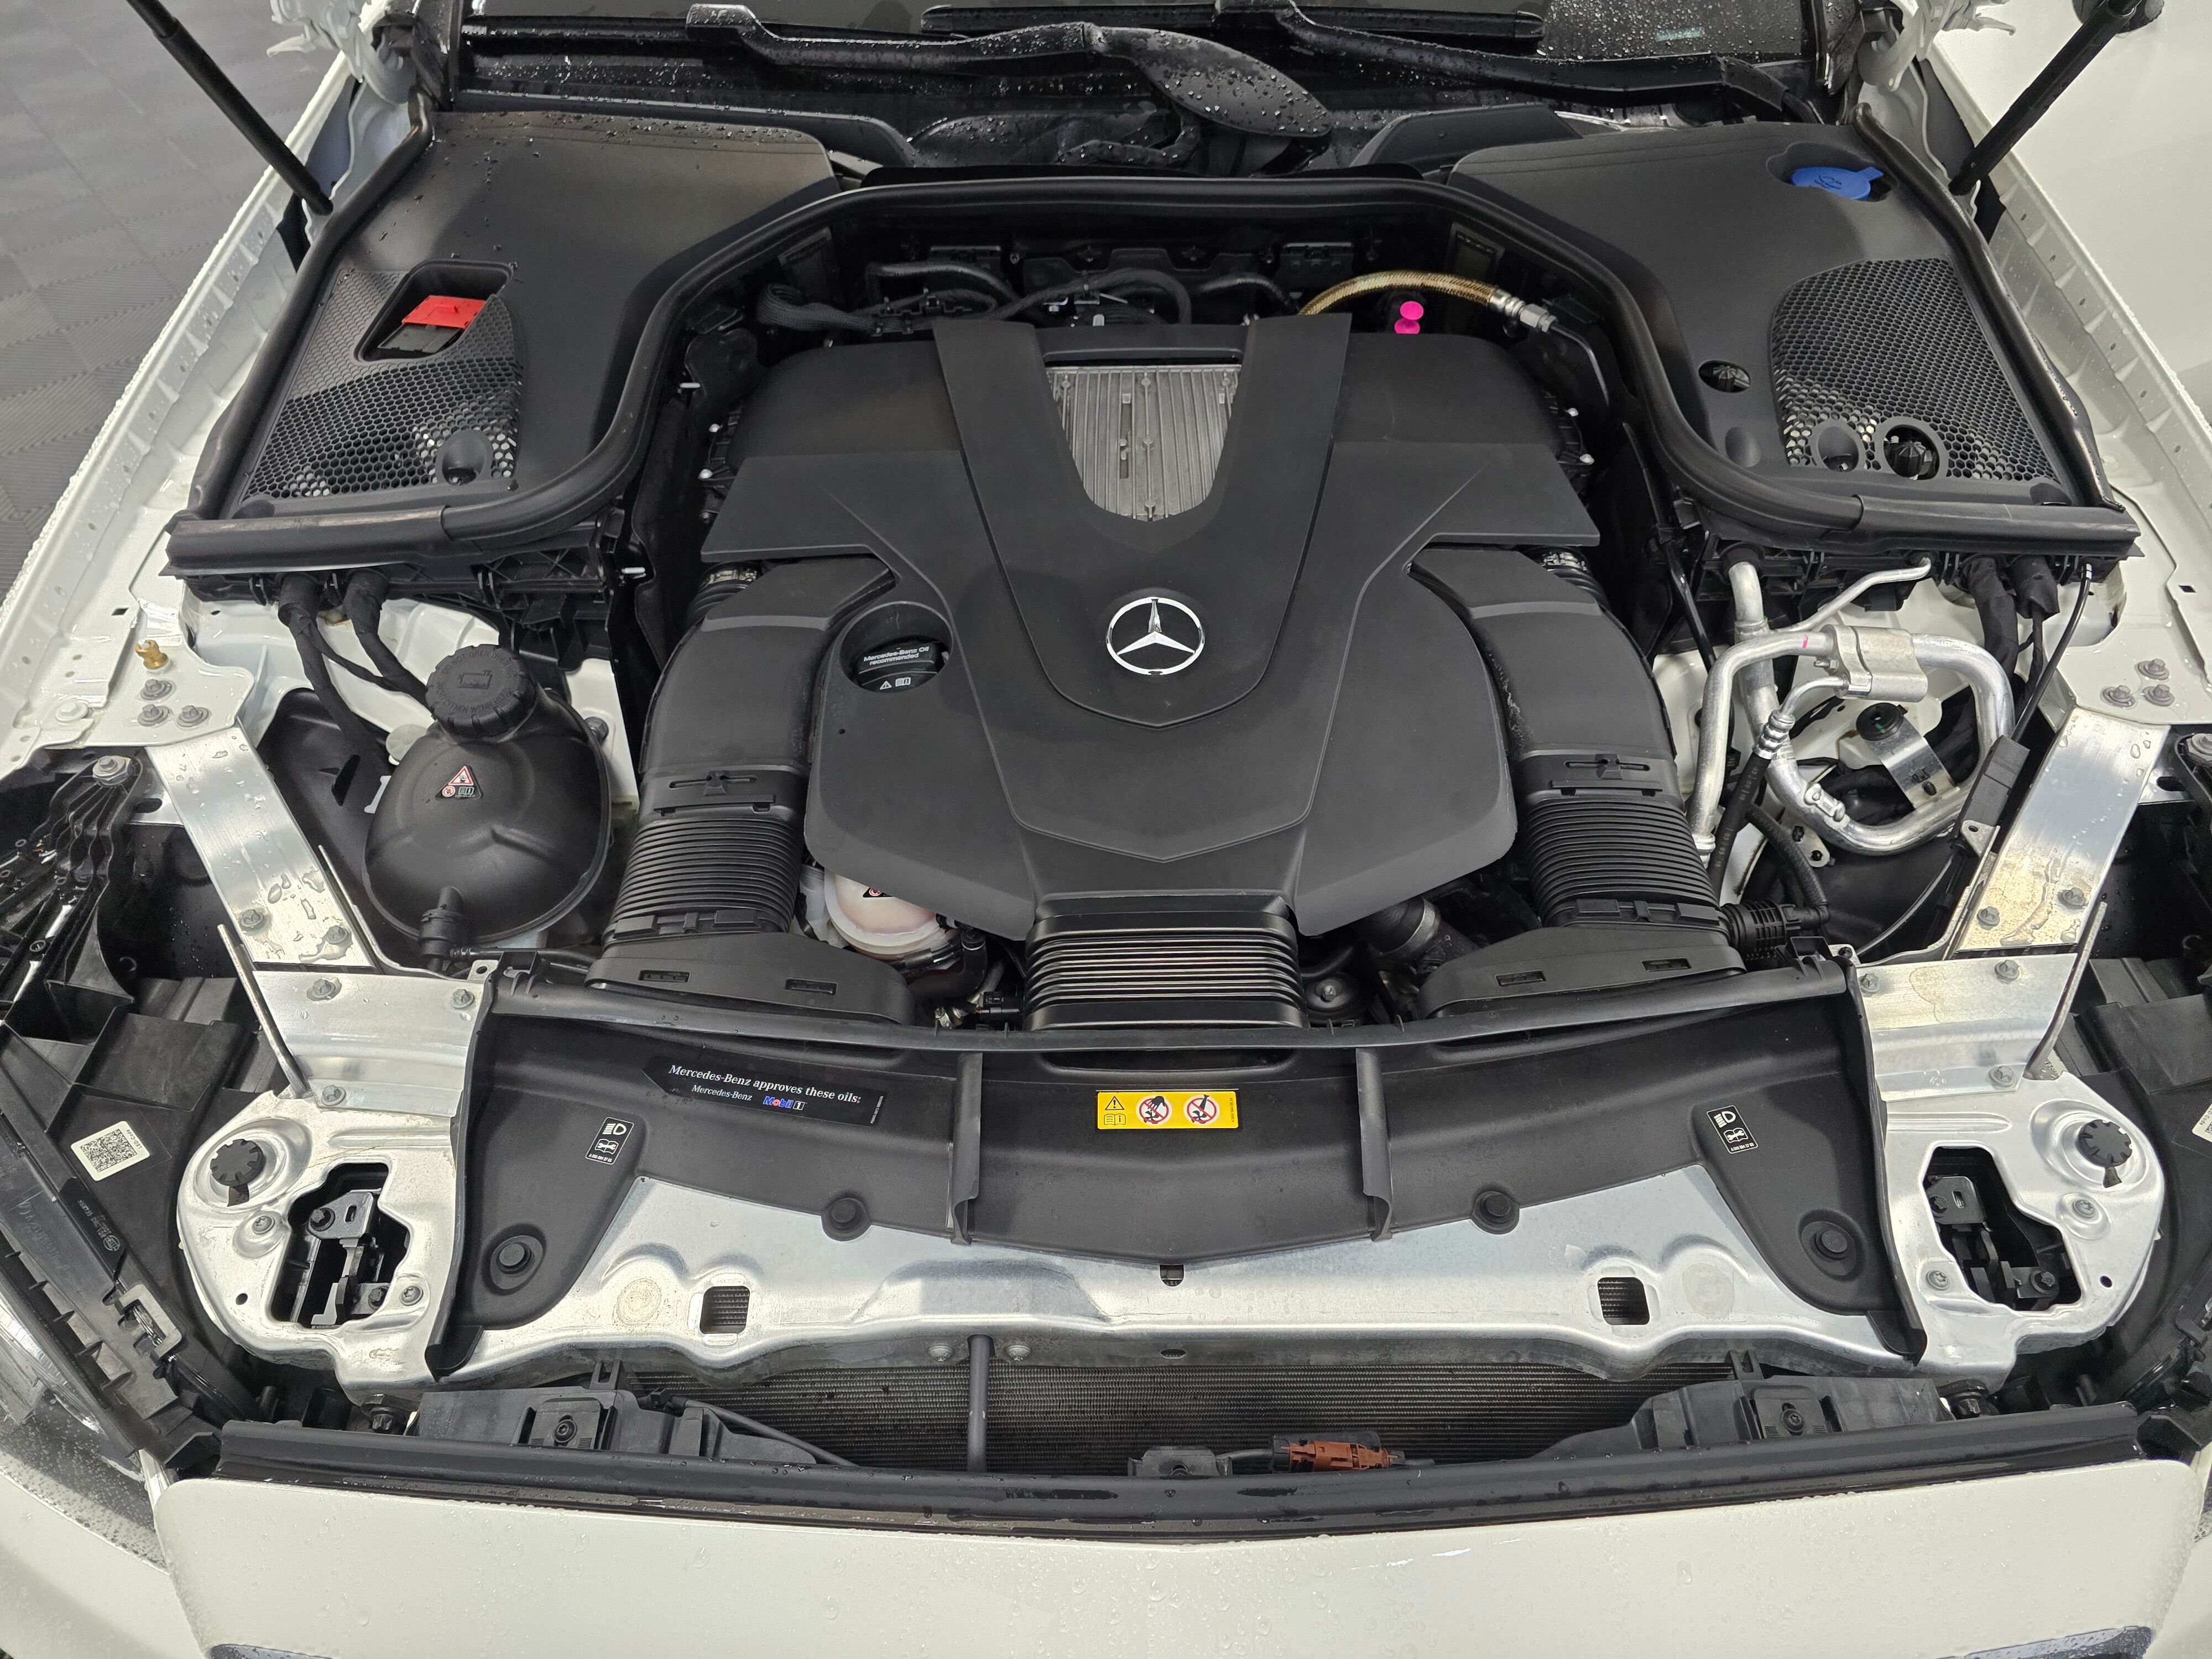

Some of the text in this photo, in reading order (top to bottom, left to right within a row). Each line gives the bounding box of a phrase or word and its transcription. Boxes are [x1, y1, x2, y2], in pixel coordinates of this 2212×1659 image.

[863, 648, 917, 662] Mercedes-Benz
[869, 653, 919, 666] recommended
[668, 1065, 862, 1104] Mercedes-Benz approves these oils:
[691, 1084, 753, 1101] Mercedes-Benz
[762, 1095, 794, 1109] Mobil
[126, 1129, 142, 1150] LED-Code
